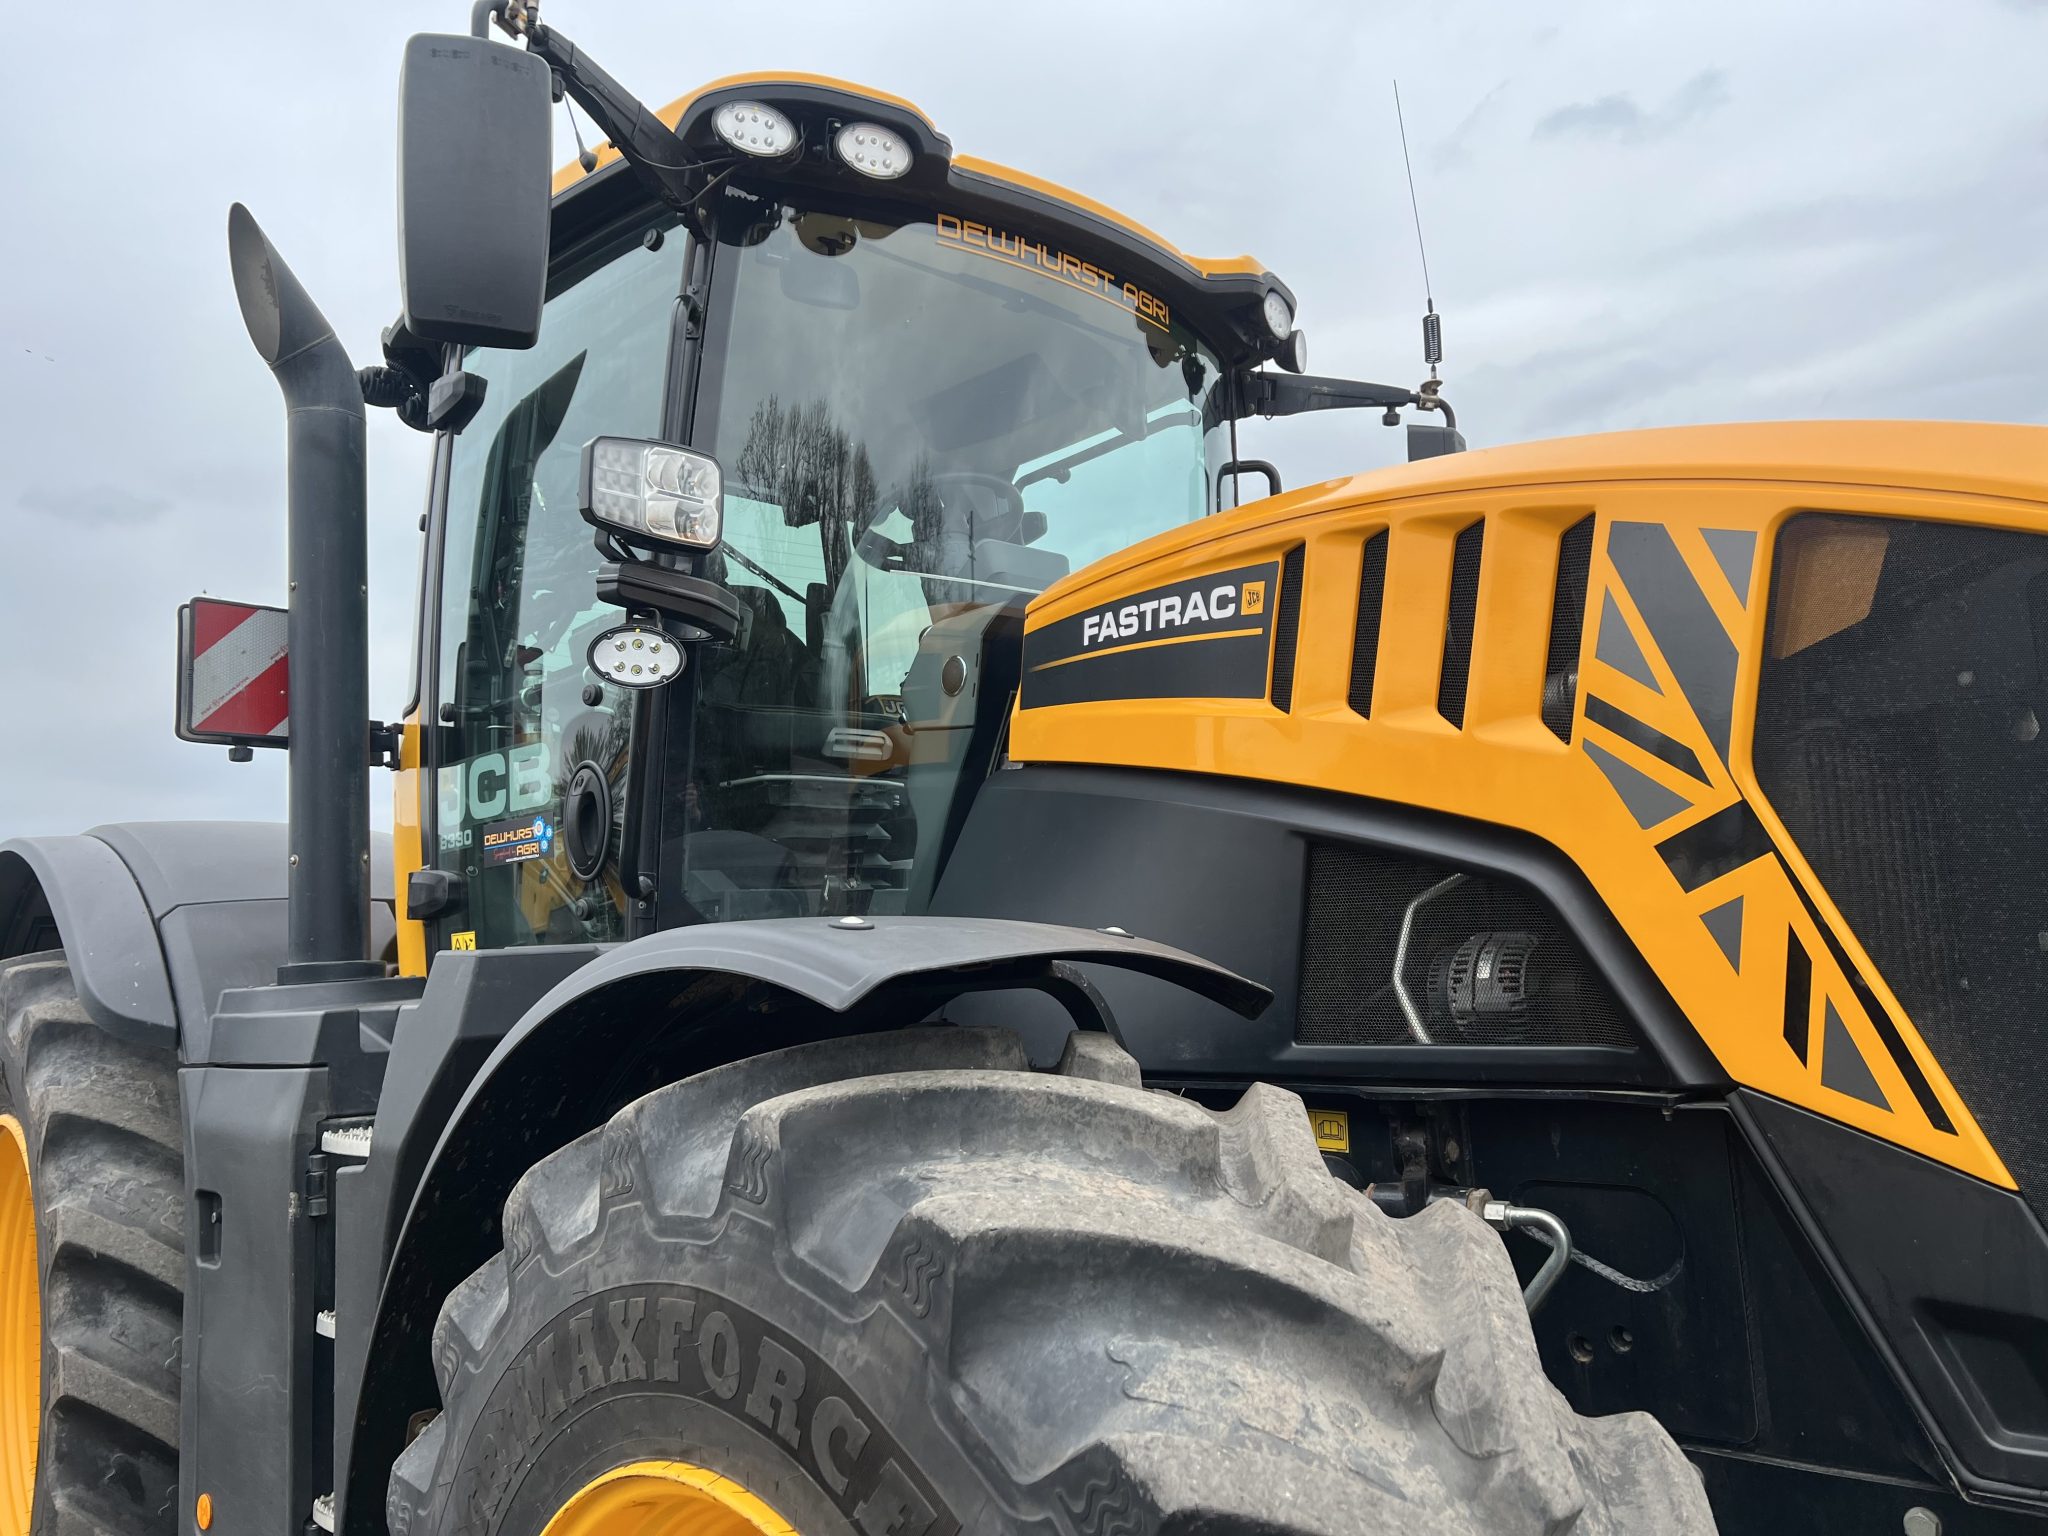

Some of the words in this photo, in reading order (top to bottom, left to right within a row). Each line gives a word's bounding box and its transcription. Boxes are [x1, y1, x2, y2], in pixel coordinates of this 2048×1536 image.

[937, 213, 1114, 292] DEWHURST
[1123, 281, 1170, 325] AGRI
[1083, 585, 1236, 646] FASTRAC
[440, 743, 552, 827] JCB
[516, 842, 539, 856] AGRI
